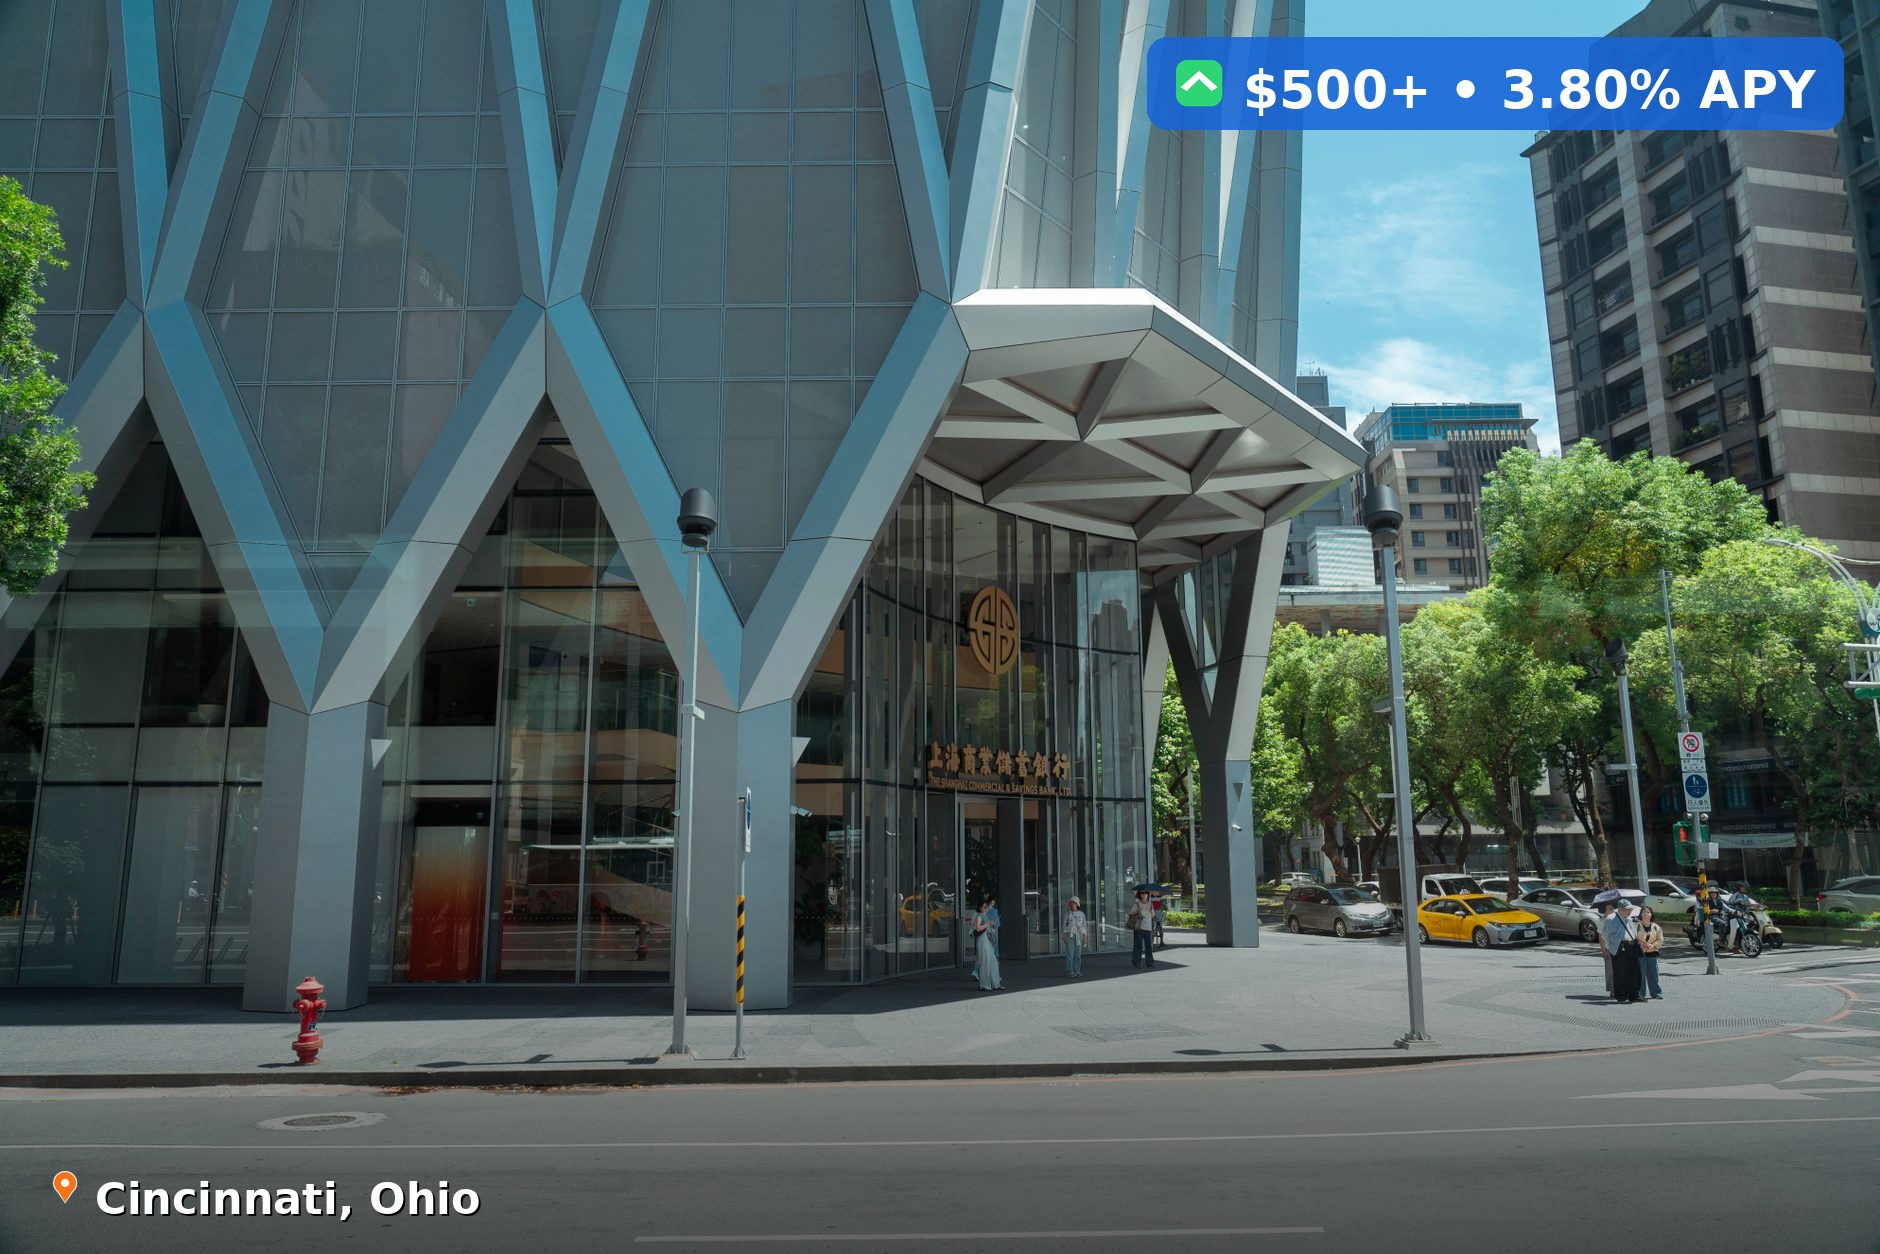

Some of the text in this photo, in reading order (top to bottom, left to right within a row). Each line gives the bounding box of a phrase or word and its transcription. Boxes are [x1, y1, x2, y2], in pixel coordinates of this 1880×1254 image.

[931, 776, 942, 786] THE
[942, 778, 967, 790] SHANGHAI
[969, 781, 1005, 793] COMMERCIAL
[1011, 784, 1038, 795] SAVINGS
